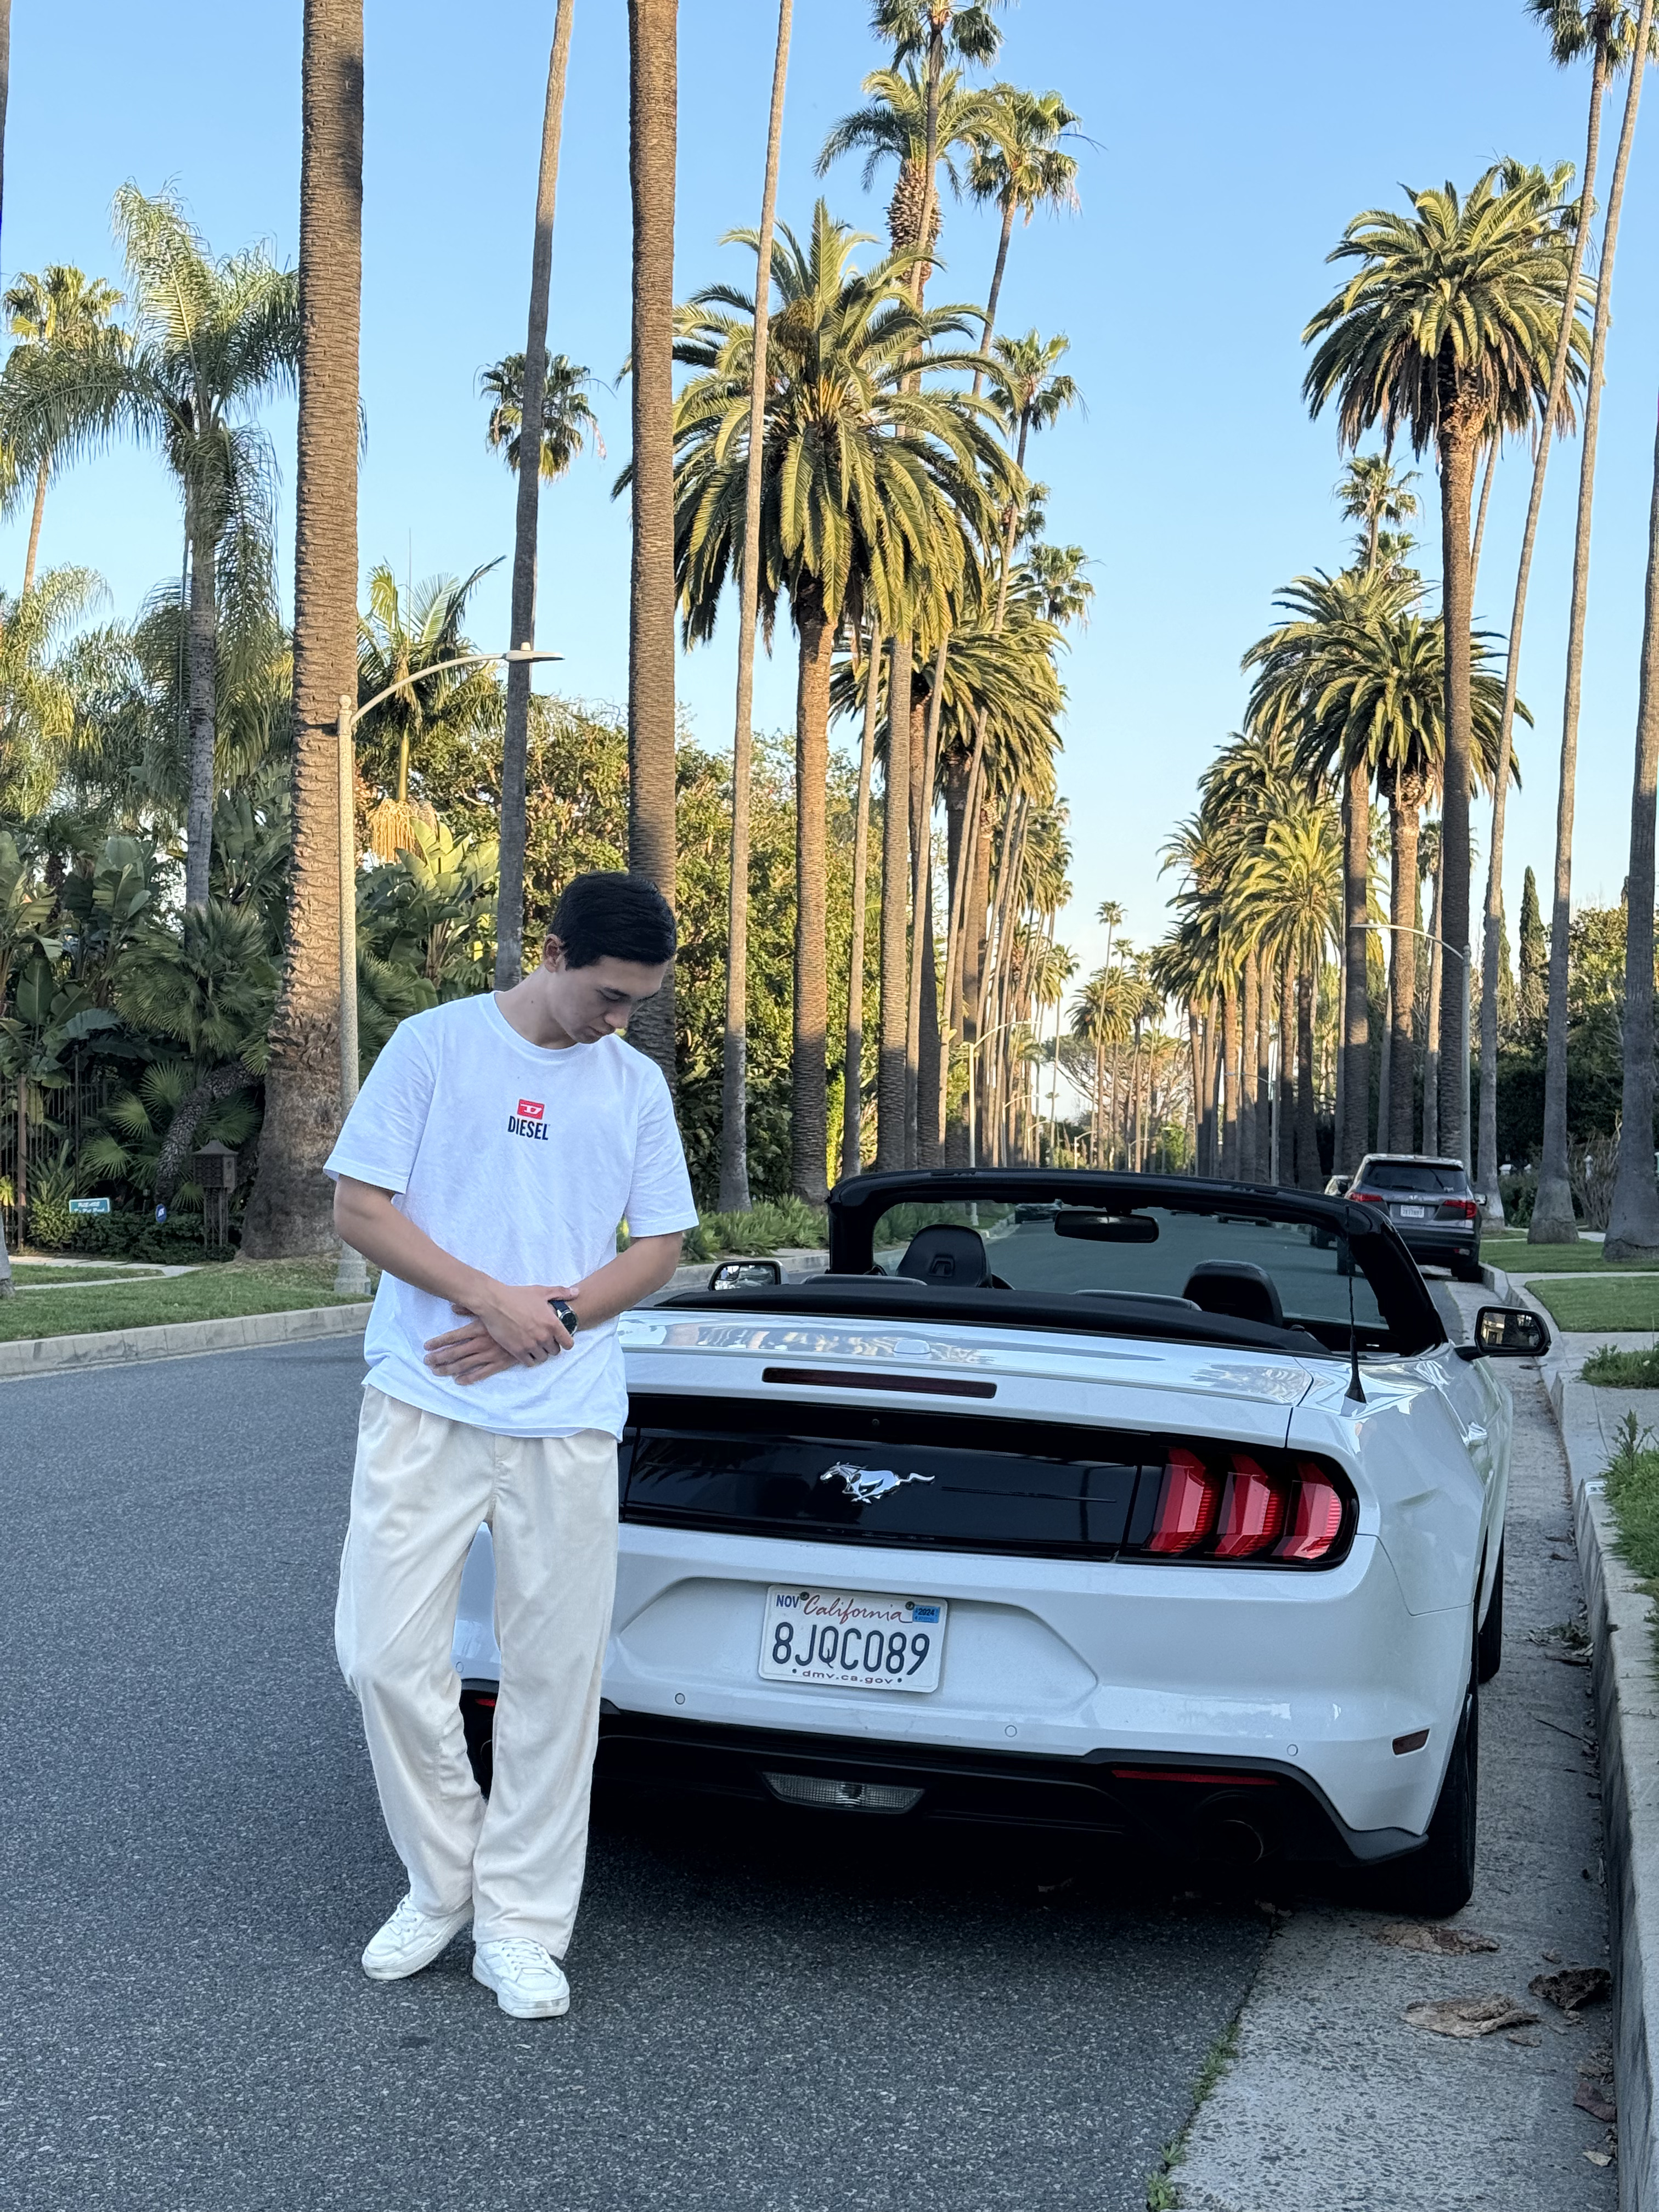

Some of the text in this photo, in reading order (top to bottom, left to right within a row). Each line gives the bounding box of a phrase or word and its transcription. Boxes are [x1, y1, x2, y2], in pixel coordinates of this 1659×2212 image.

[507, 1115, 549, 1141] DIESEL
[776, 1594, 799, 1608] NOV
[803, 1594, 913, 1624] California
[918, 1607, 935, 1616] 2024
[772, 1622, 930, 1676] 8JQC089
[803, 1669, 893, 1684] dmv.ca.gov
